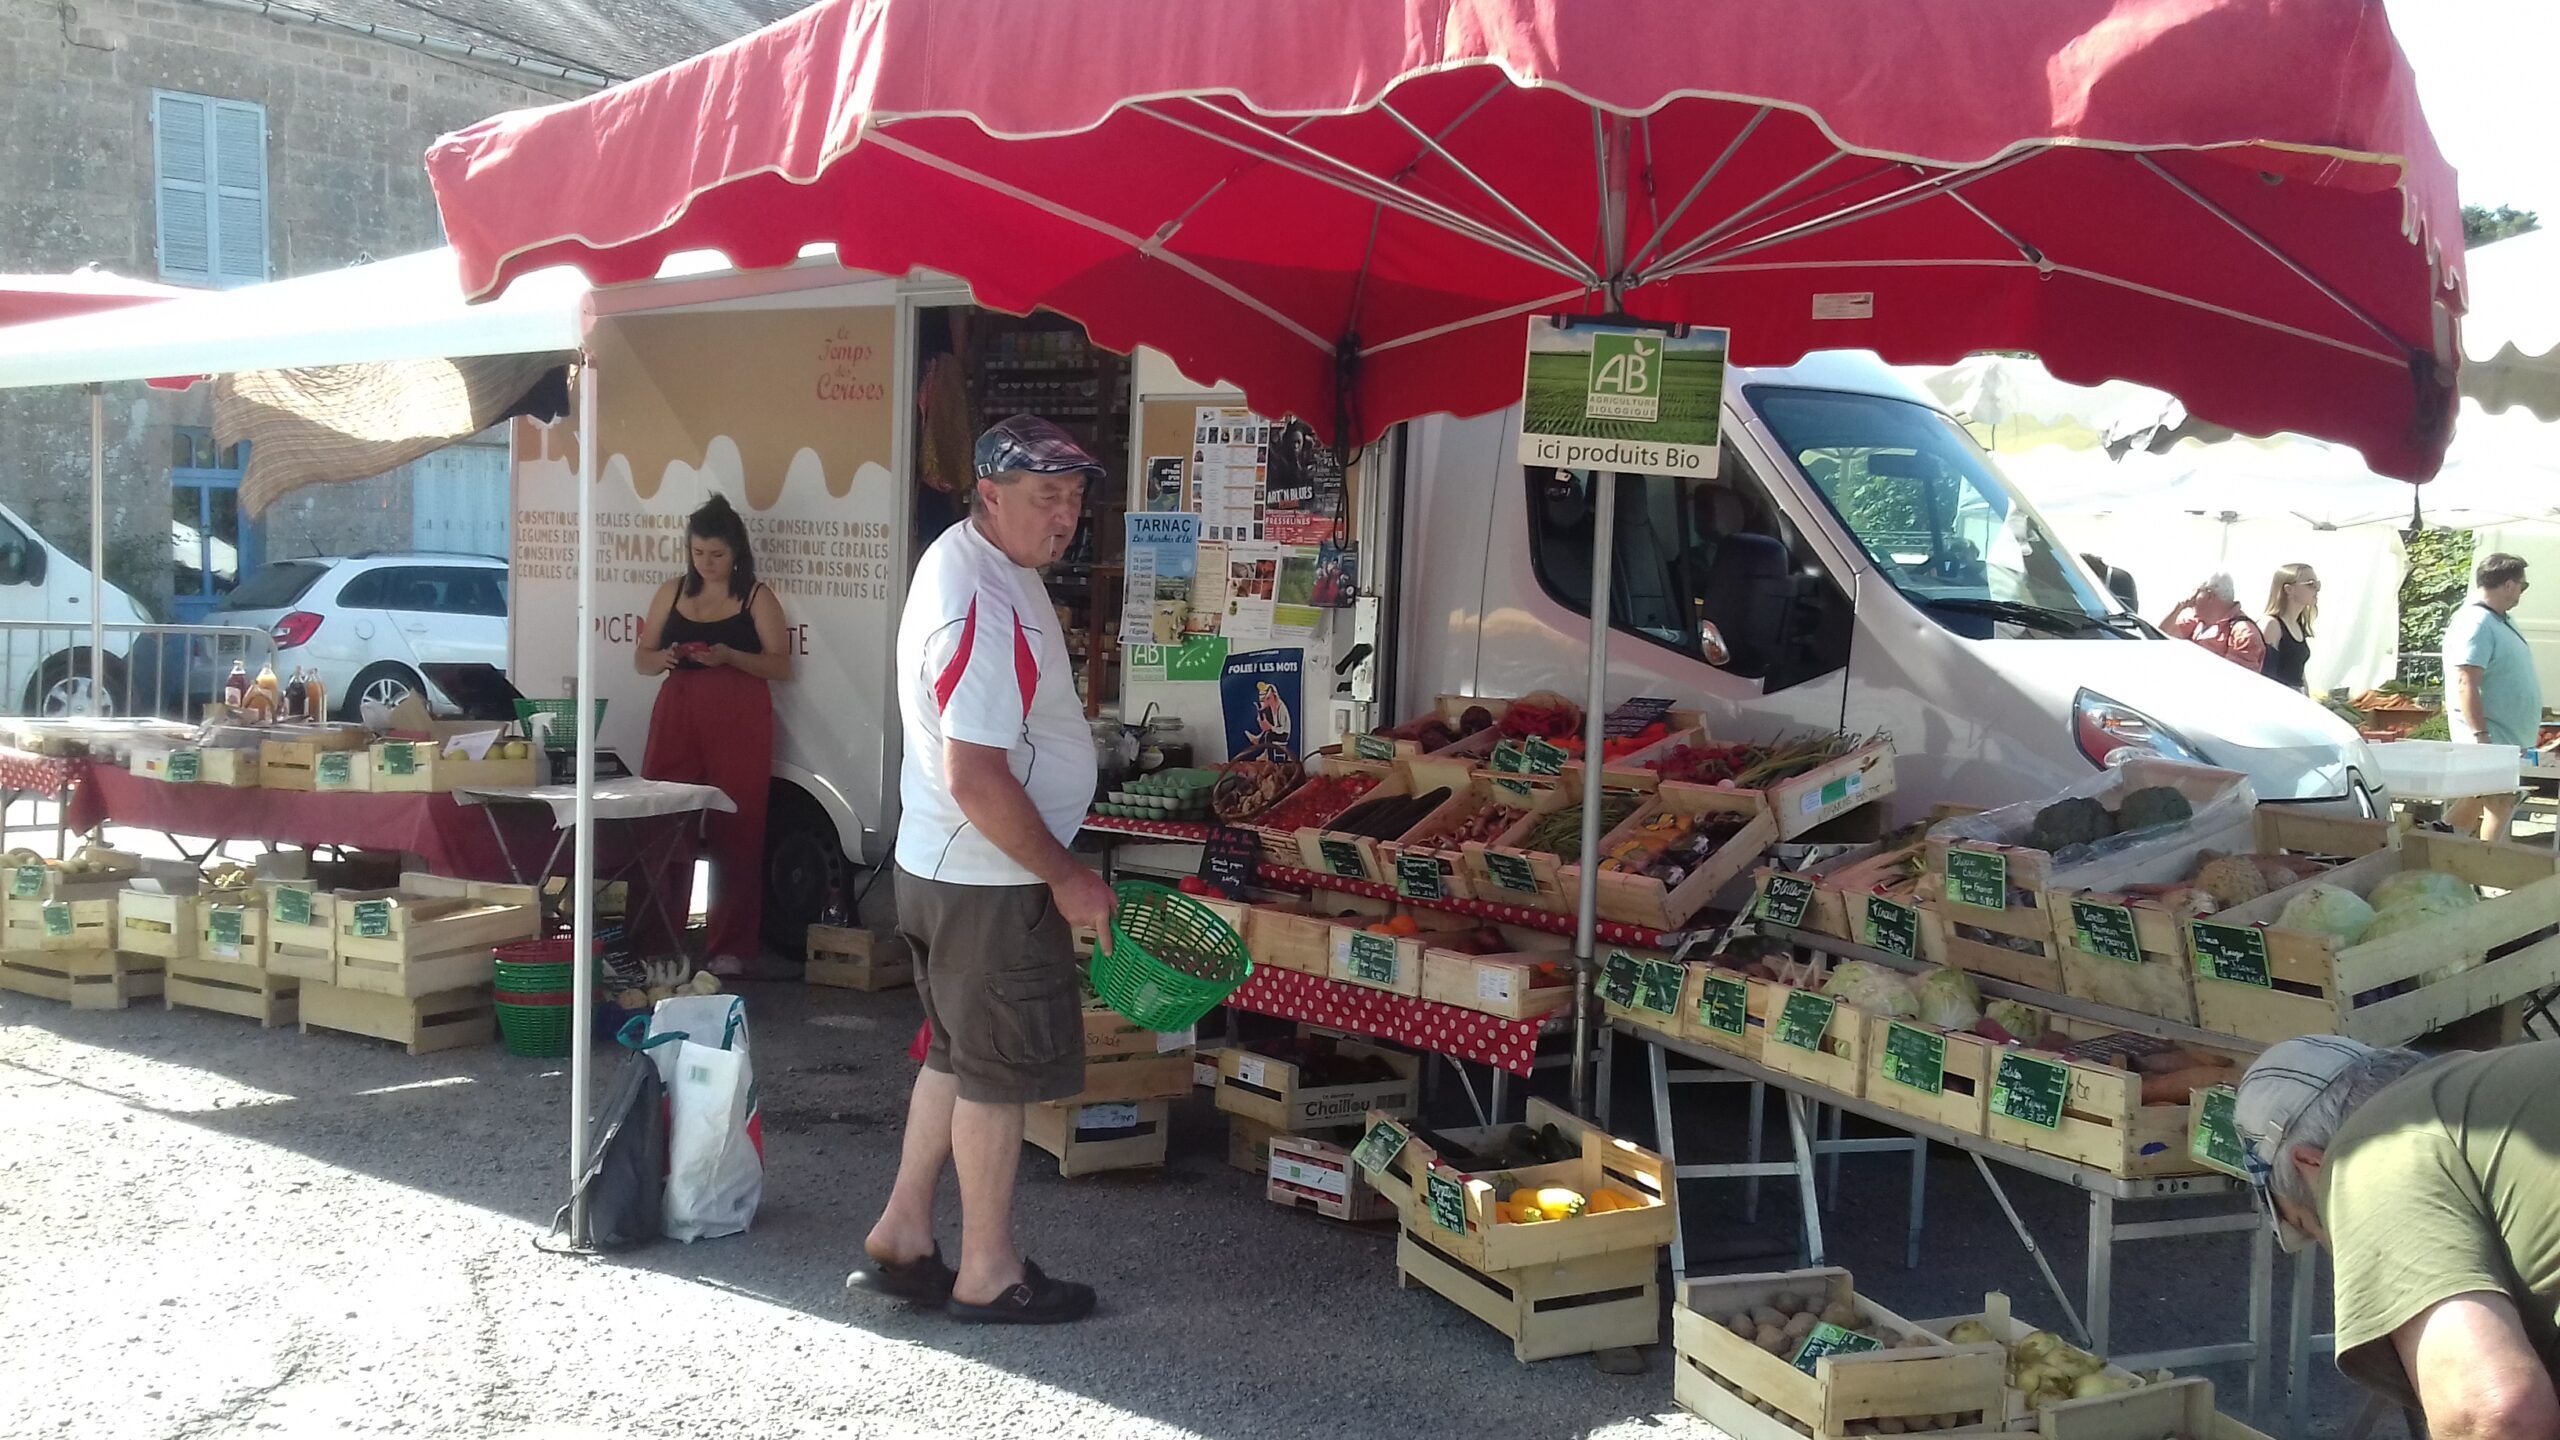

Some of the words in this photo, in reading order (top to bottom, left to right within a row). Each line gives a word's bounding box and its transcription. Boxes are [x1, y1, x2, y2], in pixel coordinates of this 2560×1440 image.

[818, 338, 872, 367] Temps
[1594, 353, 1649, 394] AB
[817, 372, 884, 401] Cerises
[1588, 406, 1656, 417] BIOLOGIQUE
[1589, 396, 1657, 408] AGRICULTURE
[1537, 439, 1560, 460] ici
[1566, 443, 1659, 467] produits
[1666, 449, 1700, 469] Bio
[769, 519, 838, 536] CONSERVES
[1134, 518, 1191, 533] TARNAC
[518, 528, 560, 544] LEGUMES
[831, 542, 889, 559] CEREALES
[518, 546, 574, 562] CONSERVES
[808, 560, 869, 579] BOISSONS
[518, 564, 561, 579] CEREALES
[827, 582, 868, 598] FRUITS
[1134, 644, 1160, 664] AB
[1259, 663, 1275, 672] LES
[1276, 662, 1298, 671] MOTS
[1305, 1099, 1370, 1116] Chaillou
